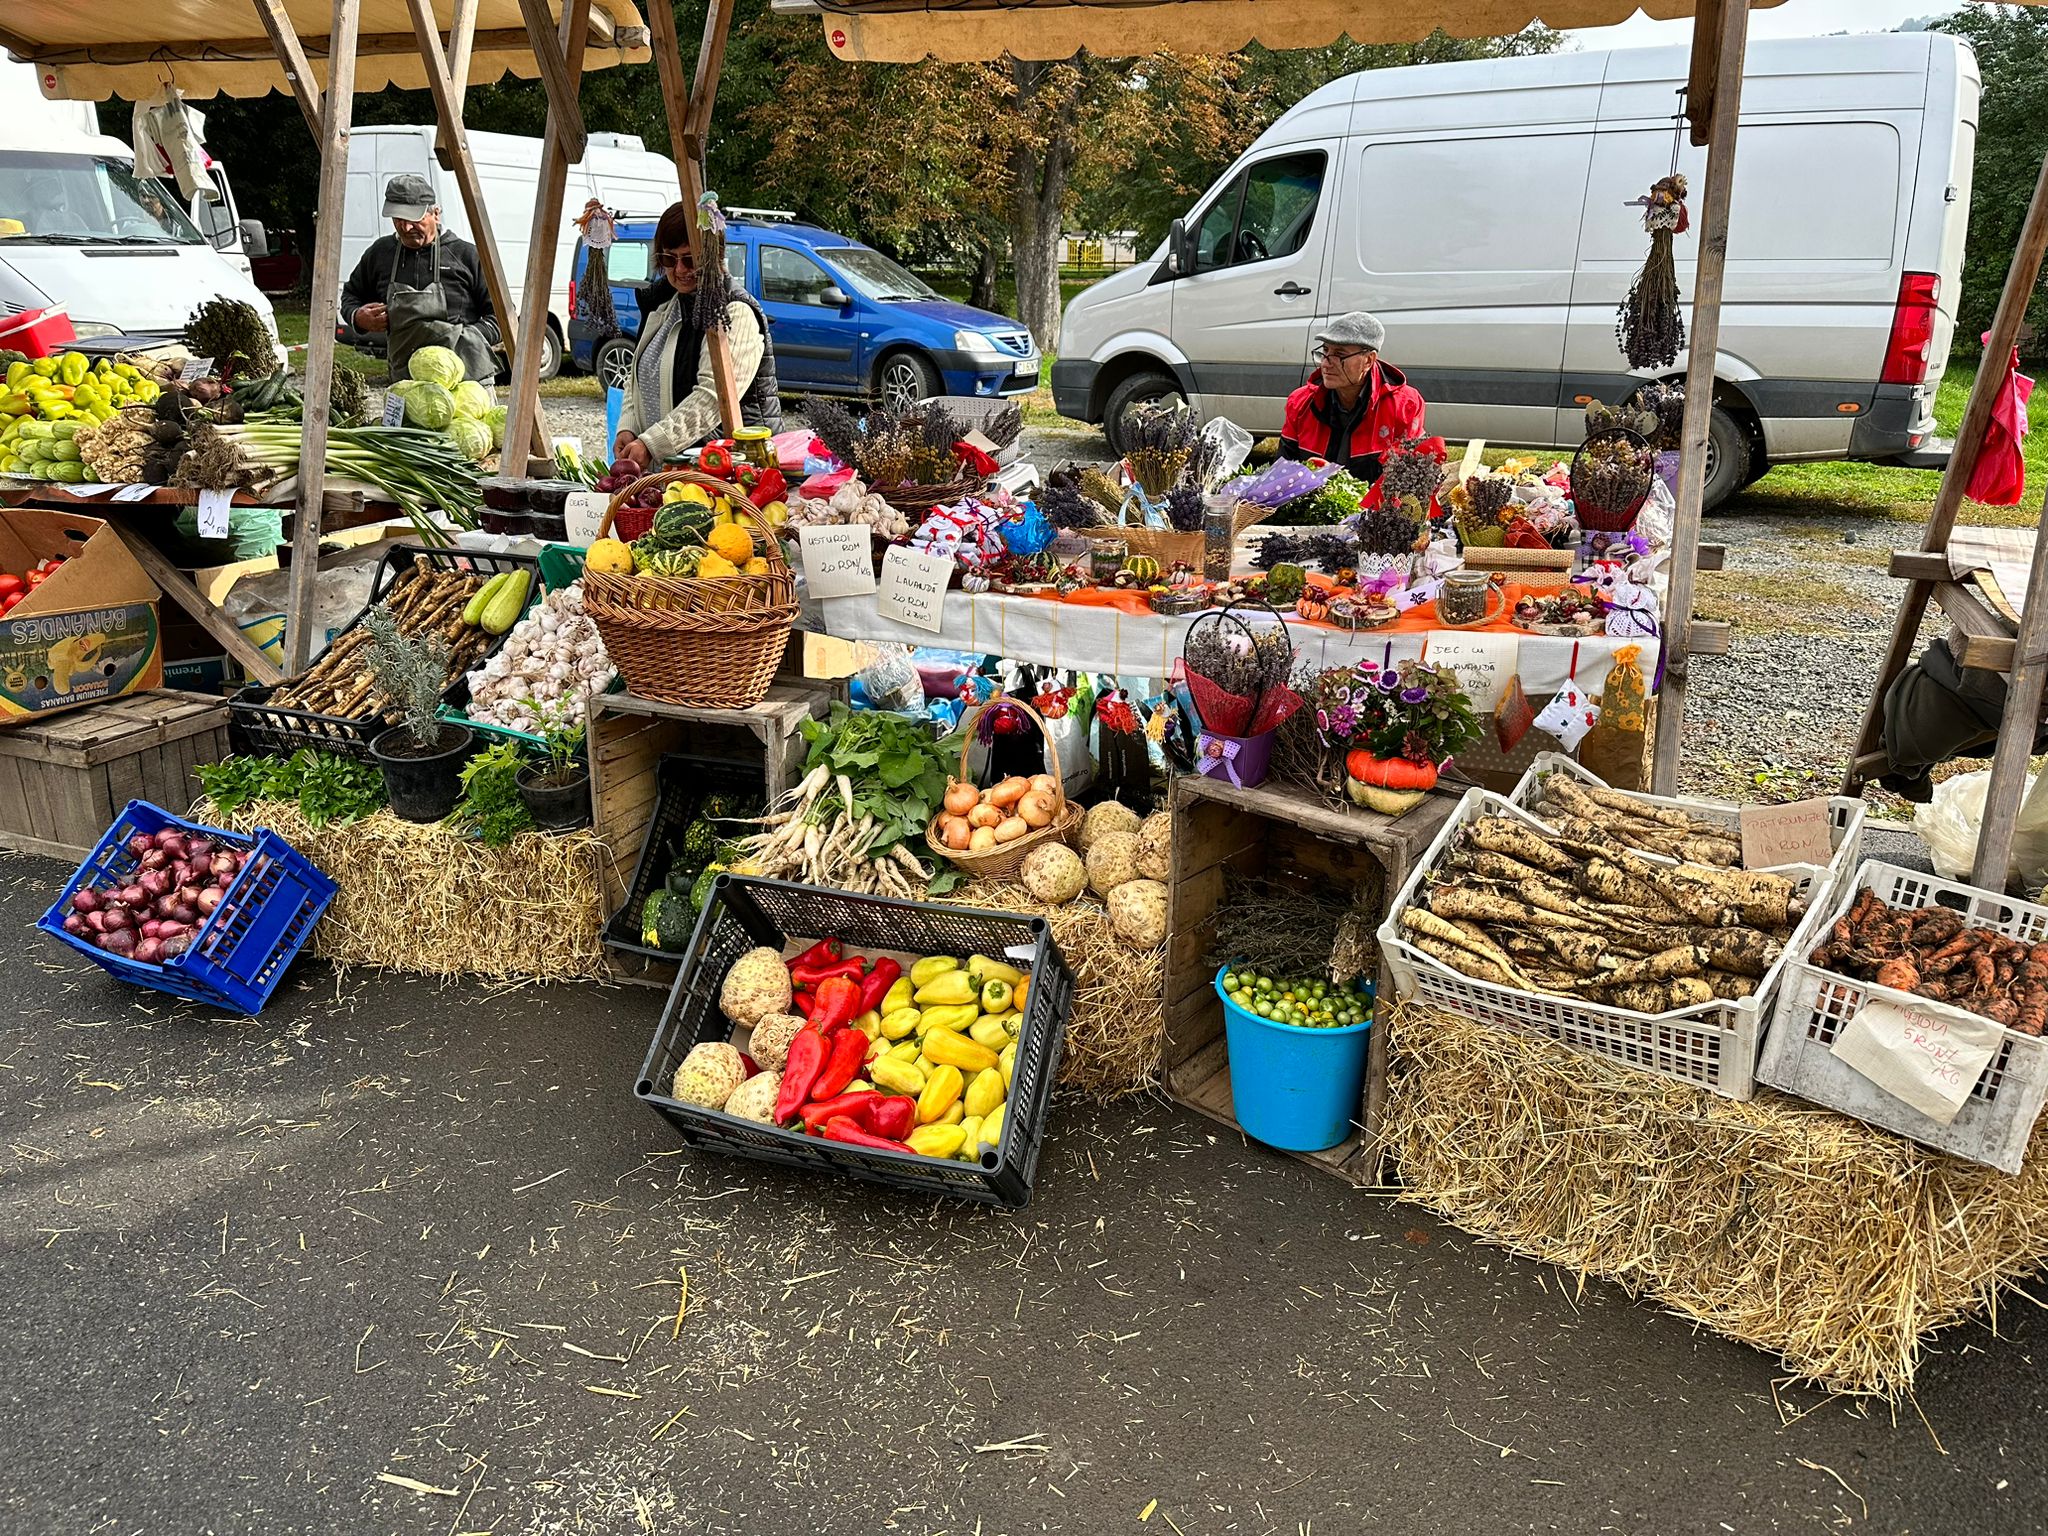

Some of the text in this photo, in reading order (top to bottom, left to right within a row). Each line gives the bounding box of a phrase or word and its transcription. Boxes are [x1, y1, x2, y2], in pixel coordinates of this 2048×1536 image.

[821, 562, 835, 573] 20
[892, 593, 906, 603] 20
[10, 608, 127, 645] BANANDES
[40, 687, 109, 709] PREMIUM BANANAS
